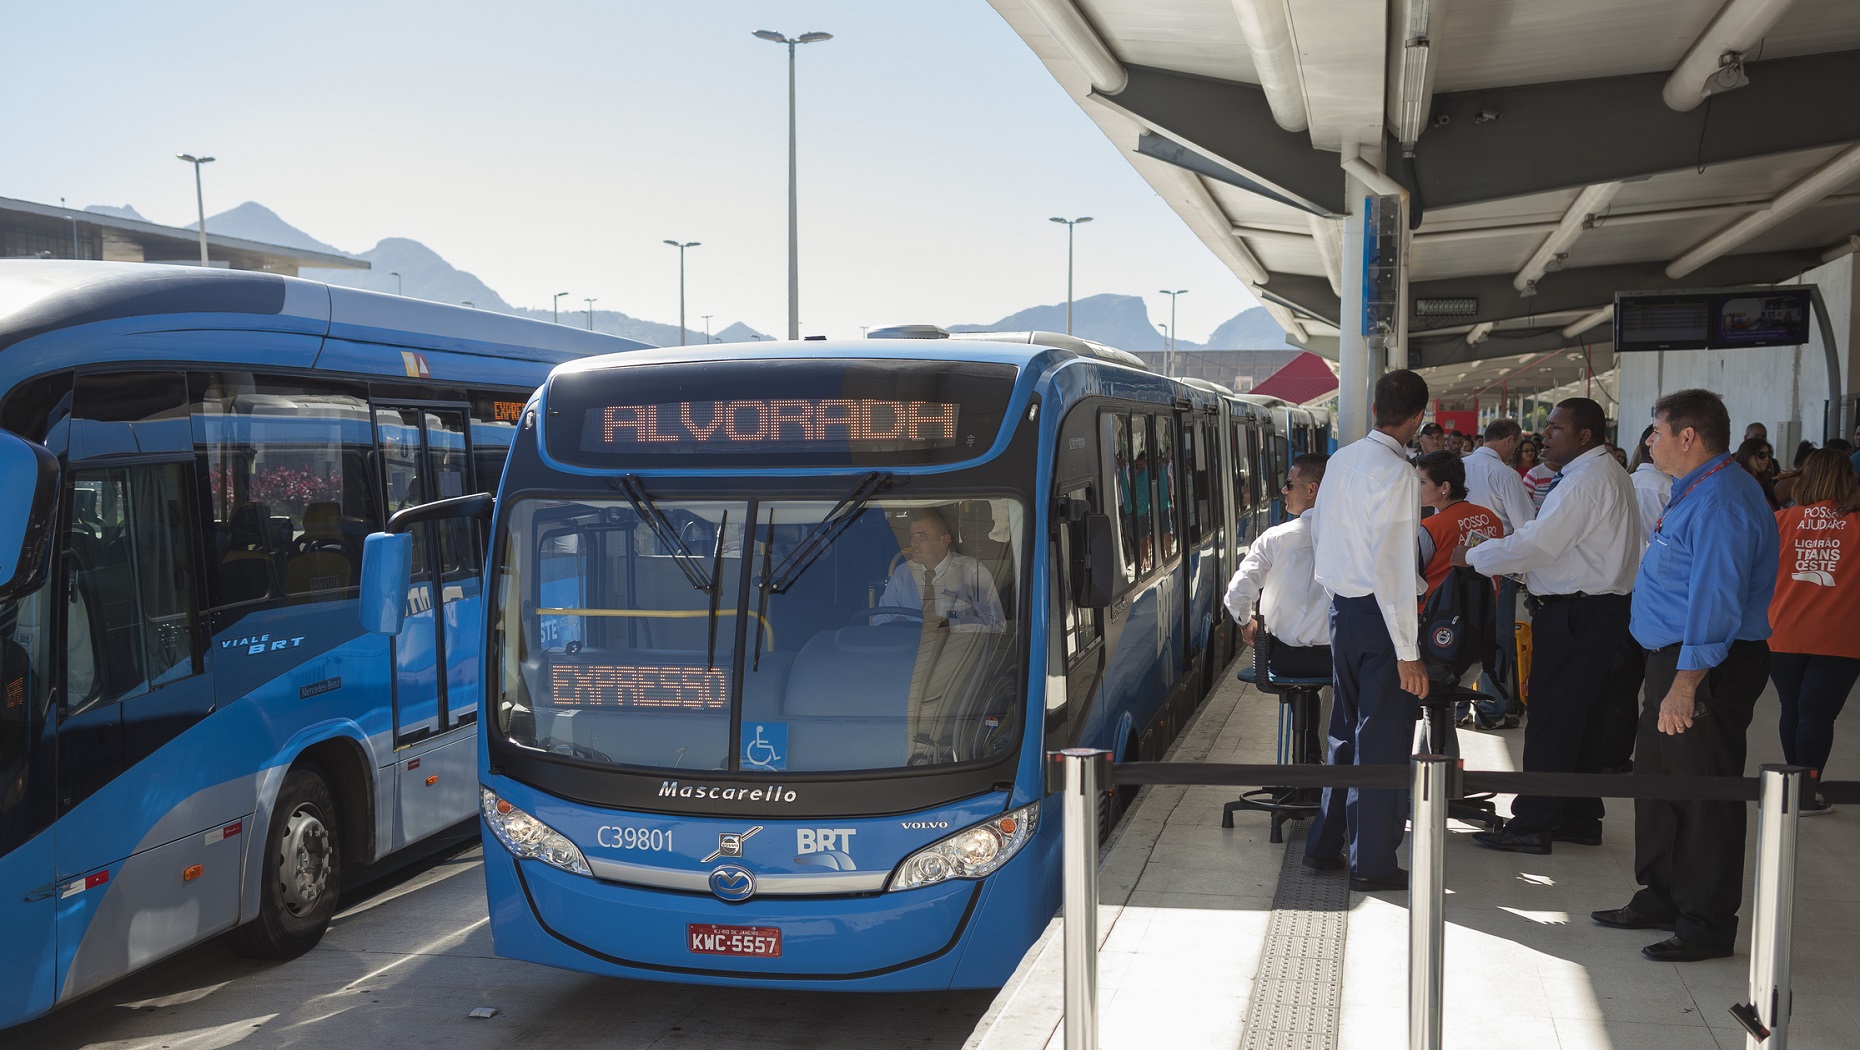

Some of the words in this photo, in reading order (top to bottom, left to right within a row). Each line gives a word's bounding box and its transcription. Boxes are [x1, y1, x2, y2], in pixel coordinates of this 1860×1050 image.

[604, 398, 954, 443] ALVORADA
[1457, 513, 1490, 531] POSSO
[1797, 519, 1846, 530] AJUDAR?
[1795, 560, 1837, 572] OESTE
[222, 634, 269, 648] VIALE
[248, 636, 304, 655] BRT
[301, 679, 341, 698] Mercedes-Benz
[552, 665, 726, 709] EXPRESSO
[658, 781, 797, 803] Mascarello
[901, 821, 949, 830] VOLVO
[597, 825, 674, 852] C39801
[796, 828, 857, 855] BRT
